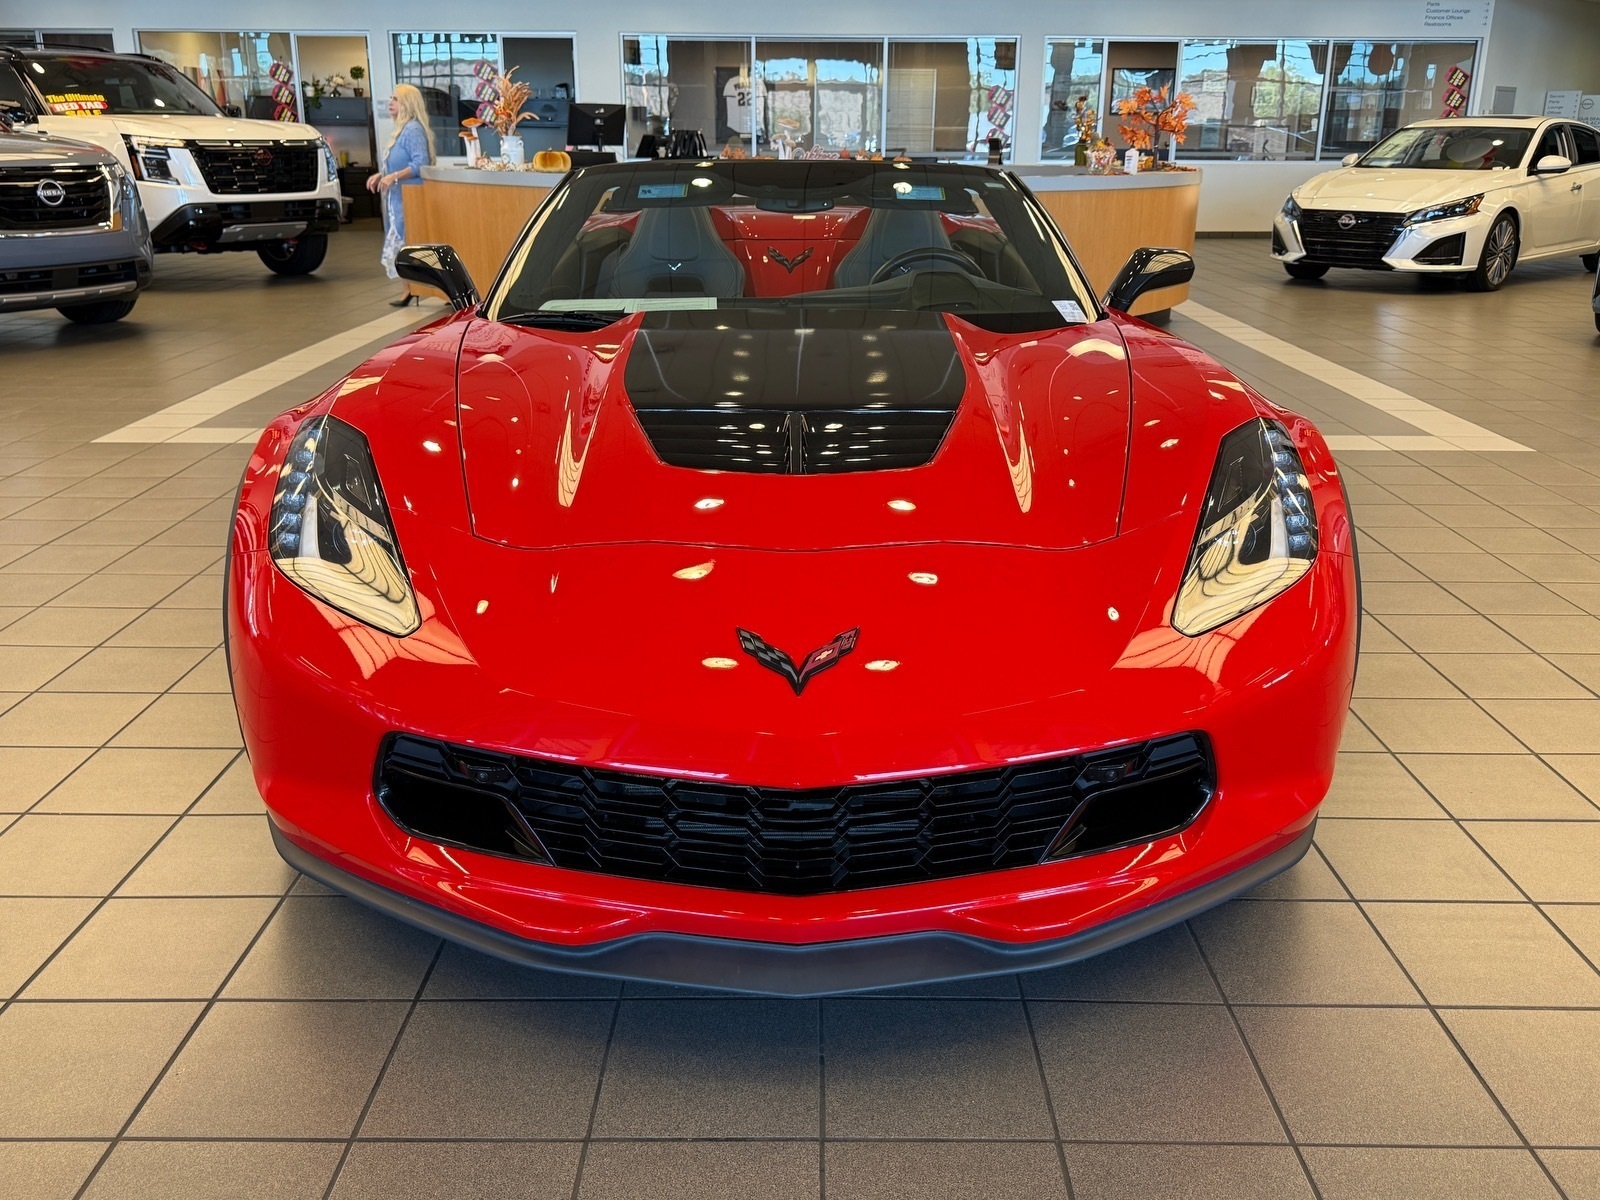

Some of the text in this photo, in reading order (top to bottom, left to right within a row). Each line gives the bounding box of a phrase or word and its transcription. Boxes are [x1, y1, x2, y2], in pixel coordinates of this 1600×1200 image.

[46, 93, 105, 103] The Ultimate
[737, 92, 752, 106] 22
[53, 101, 104, 111] RED TAG
